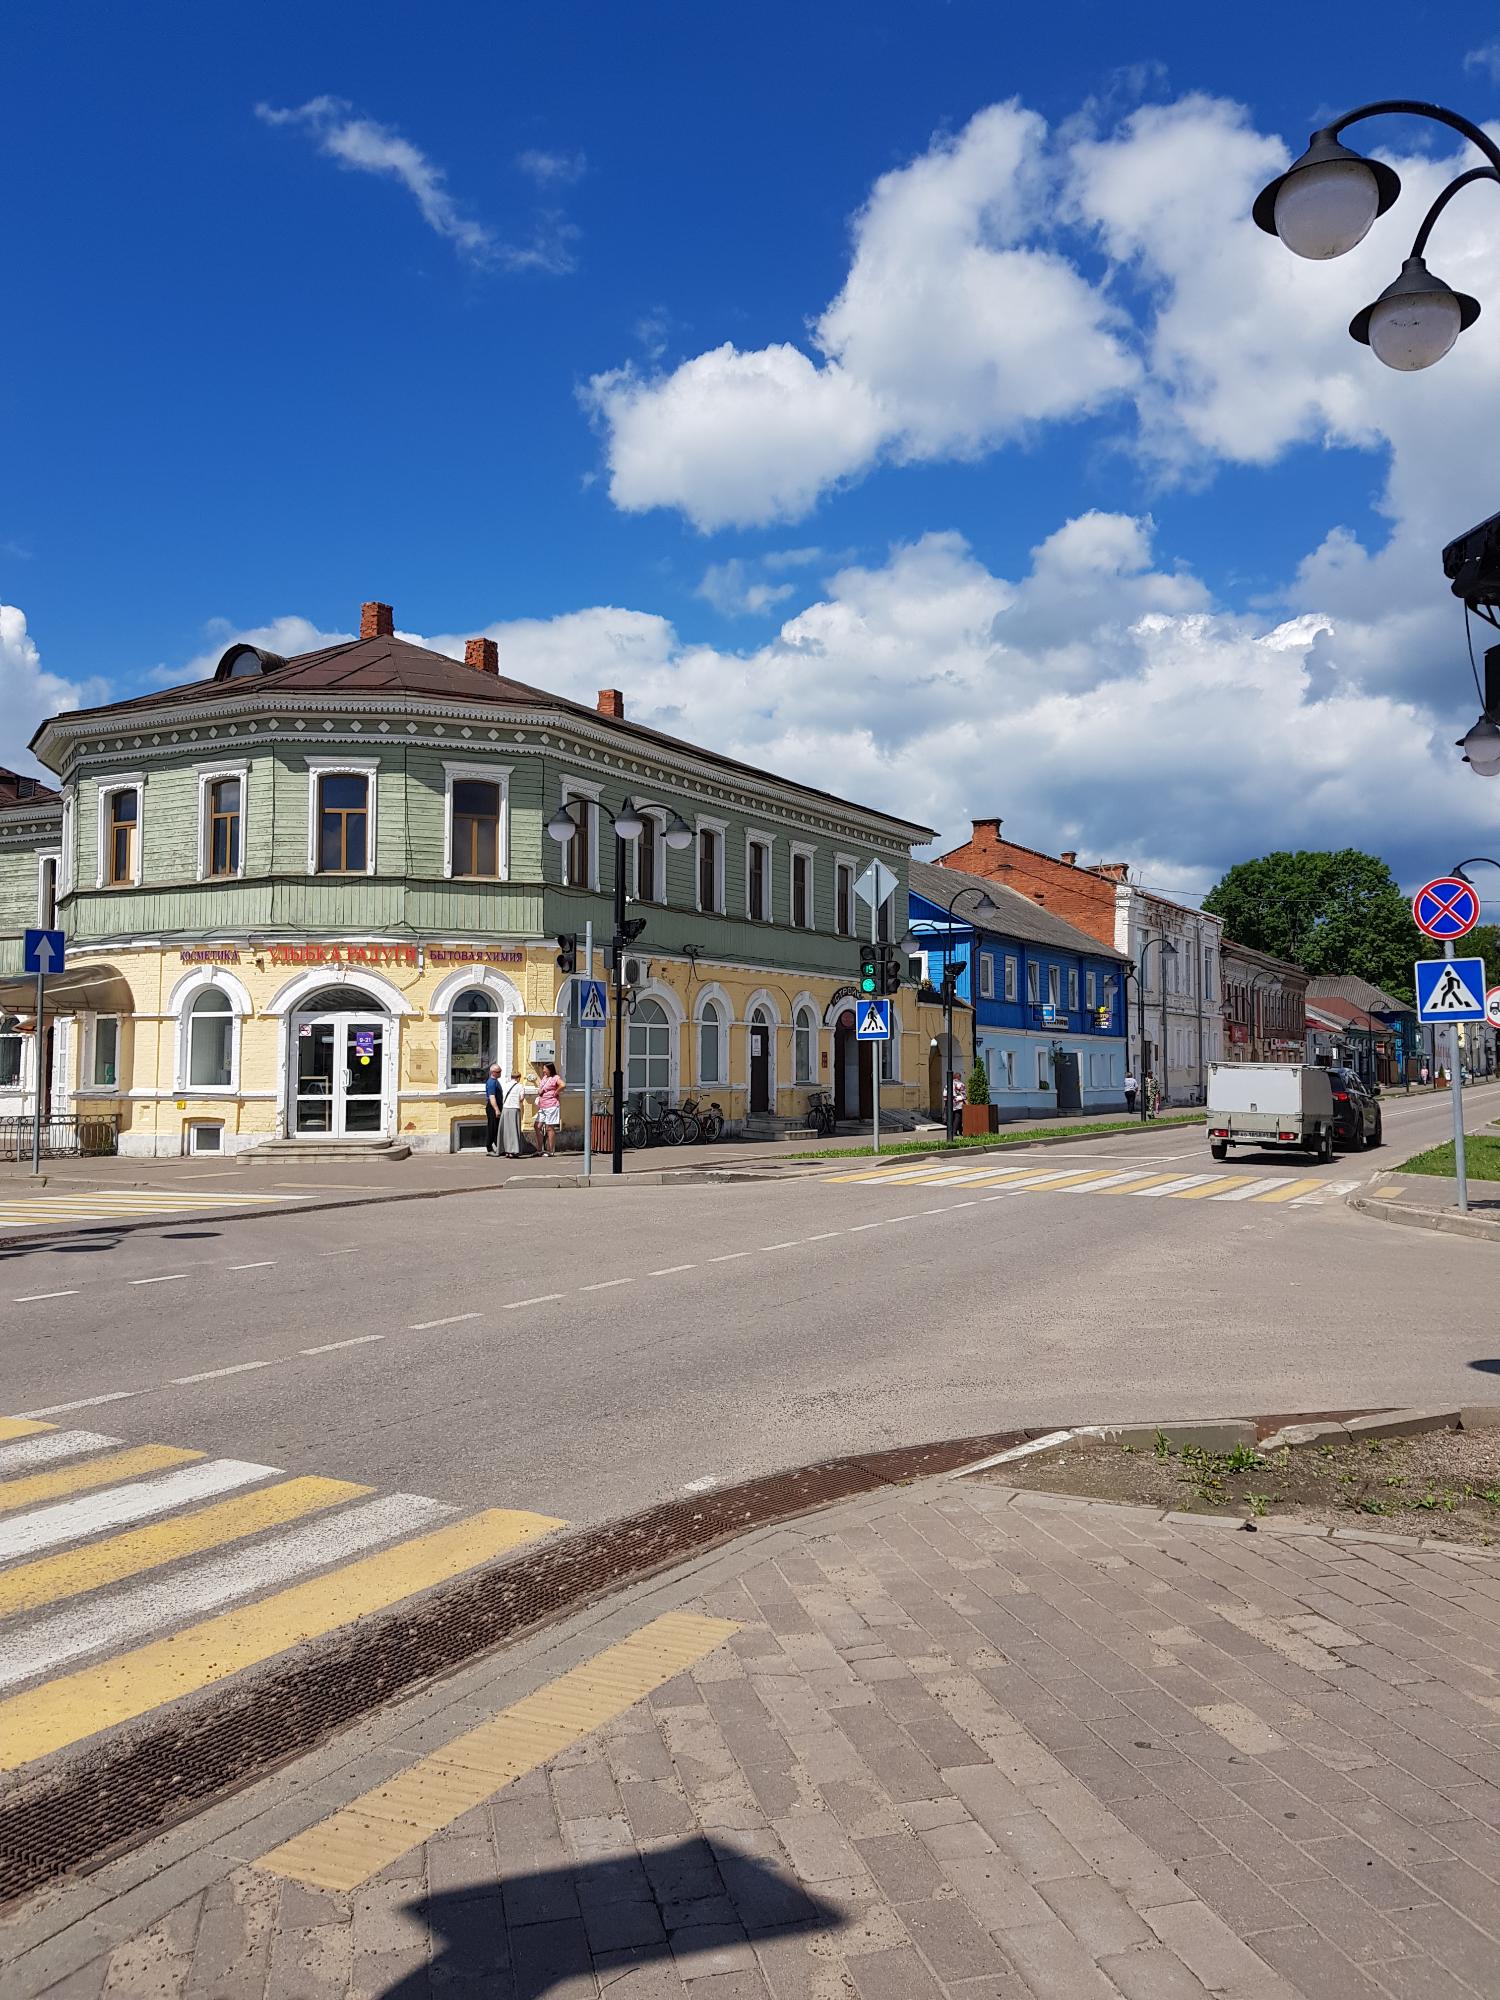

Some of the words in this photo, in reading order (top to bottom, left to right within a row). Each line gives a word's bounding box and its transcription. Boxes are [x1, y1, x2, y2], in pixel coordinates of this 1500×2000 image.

[180, 950, 239, 961] КОСМЕТИКА
[268, 945, 342, 962] УЛЫБКА
[347, 946, 416, 962] РАДУГИ
[430, 950, 483, 962] БЫТОВАЯ
[485, 952, 523, 963] ХИМИЯ
[865, 965, 874, 973] 15
